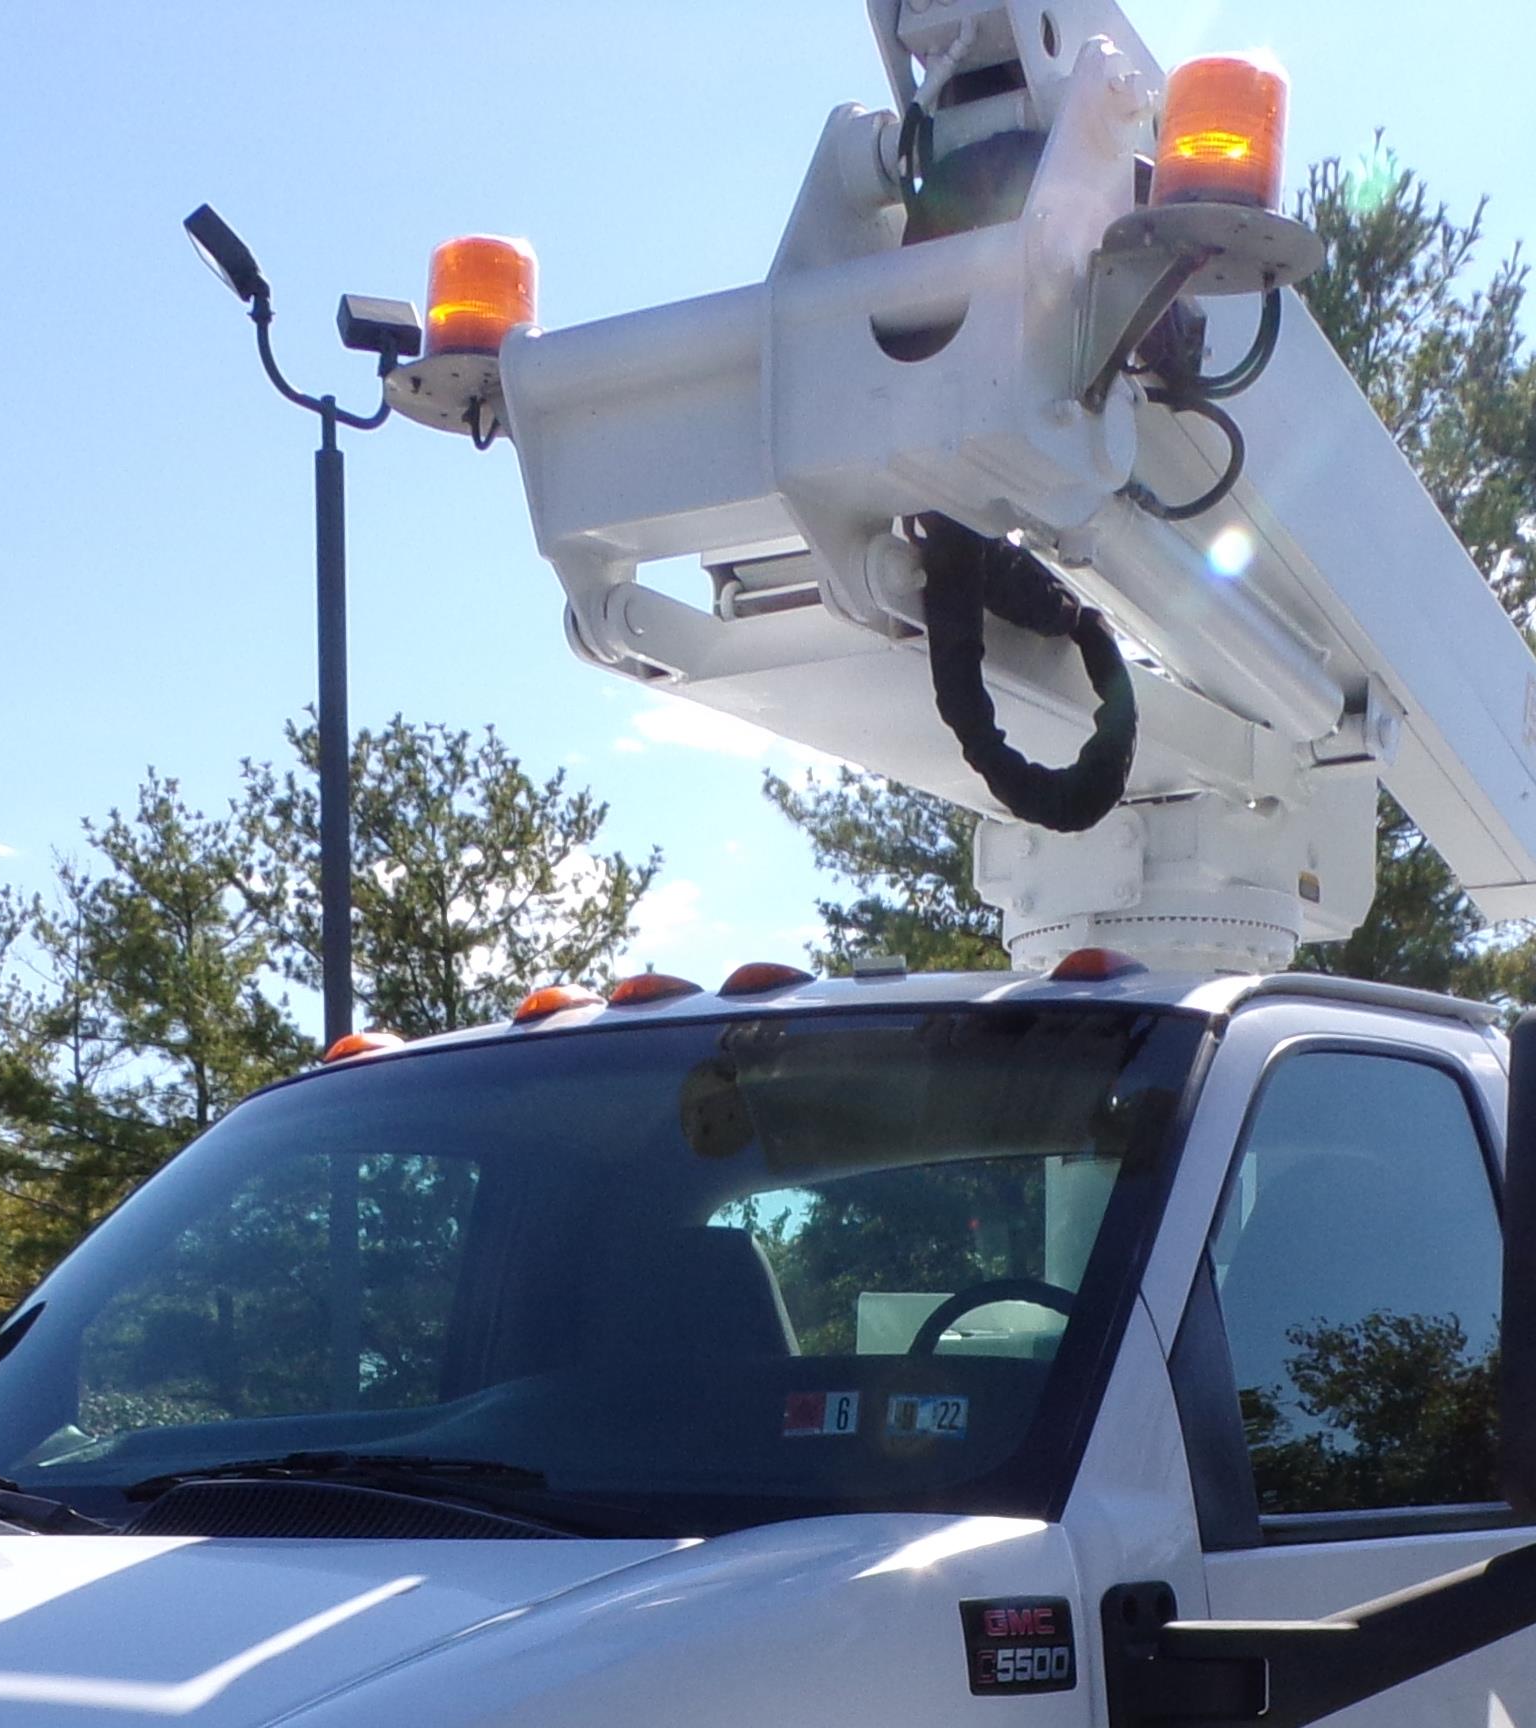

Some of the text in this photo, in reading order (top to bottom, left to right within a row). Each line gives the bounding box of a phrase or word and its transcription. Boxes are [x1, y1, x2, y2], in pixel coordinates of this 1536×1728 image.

[836, 1396, 850, 1431] 6
[936, 1401, 961, 1430] 22
[984, 1608, 1056, 1637] GMC
